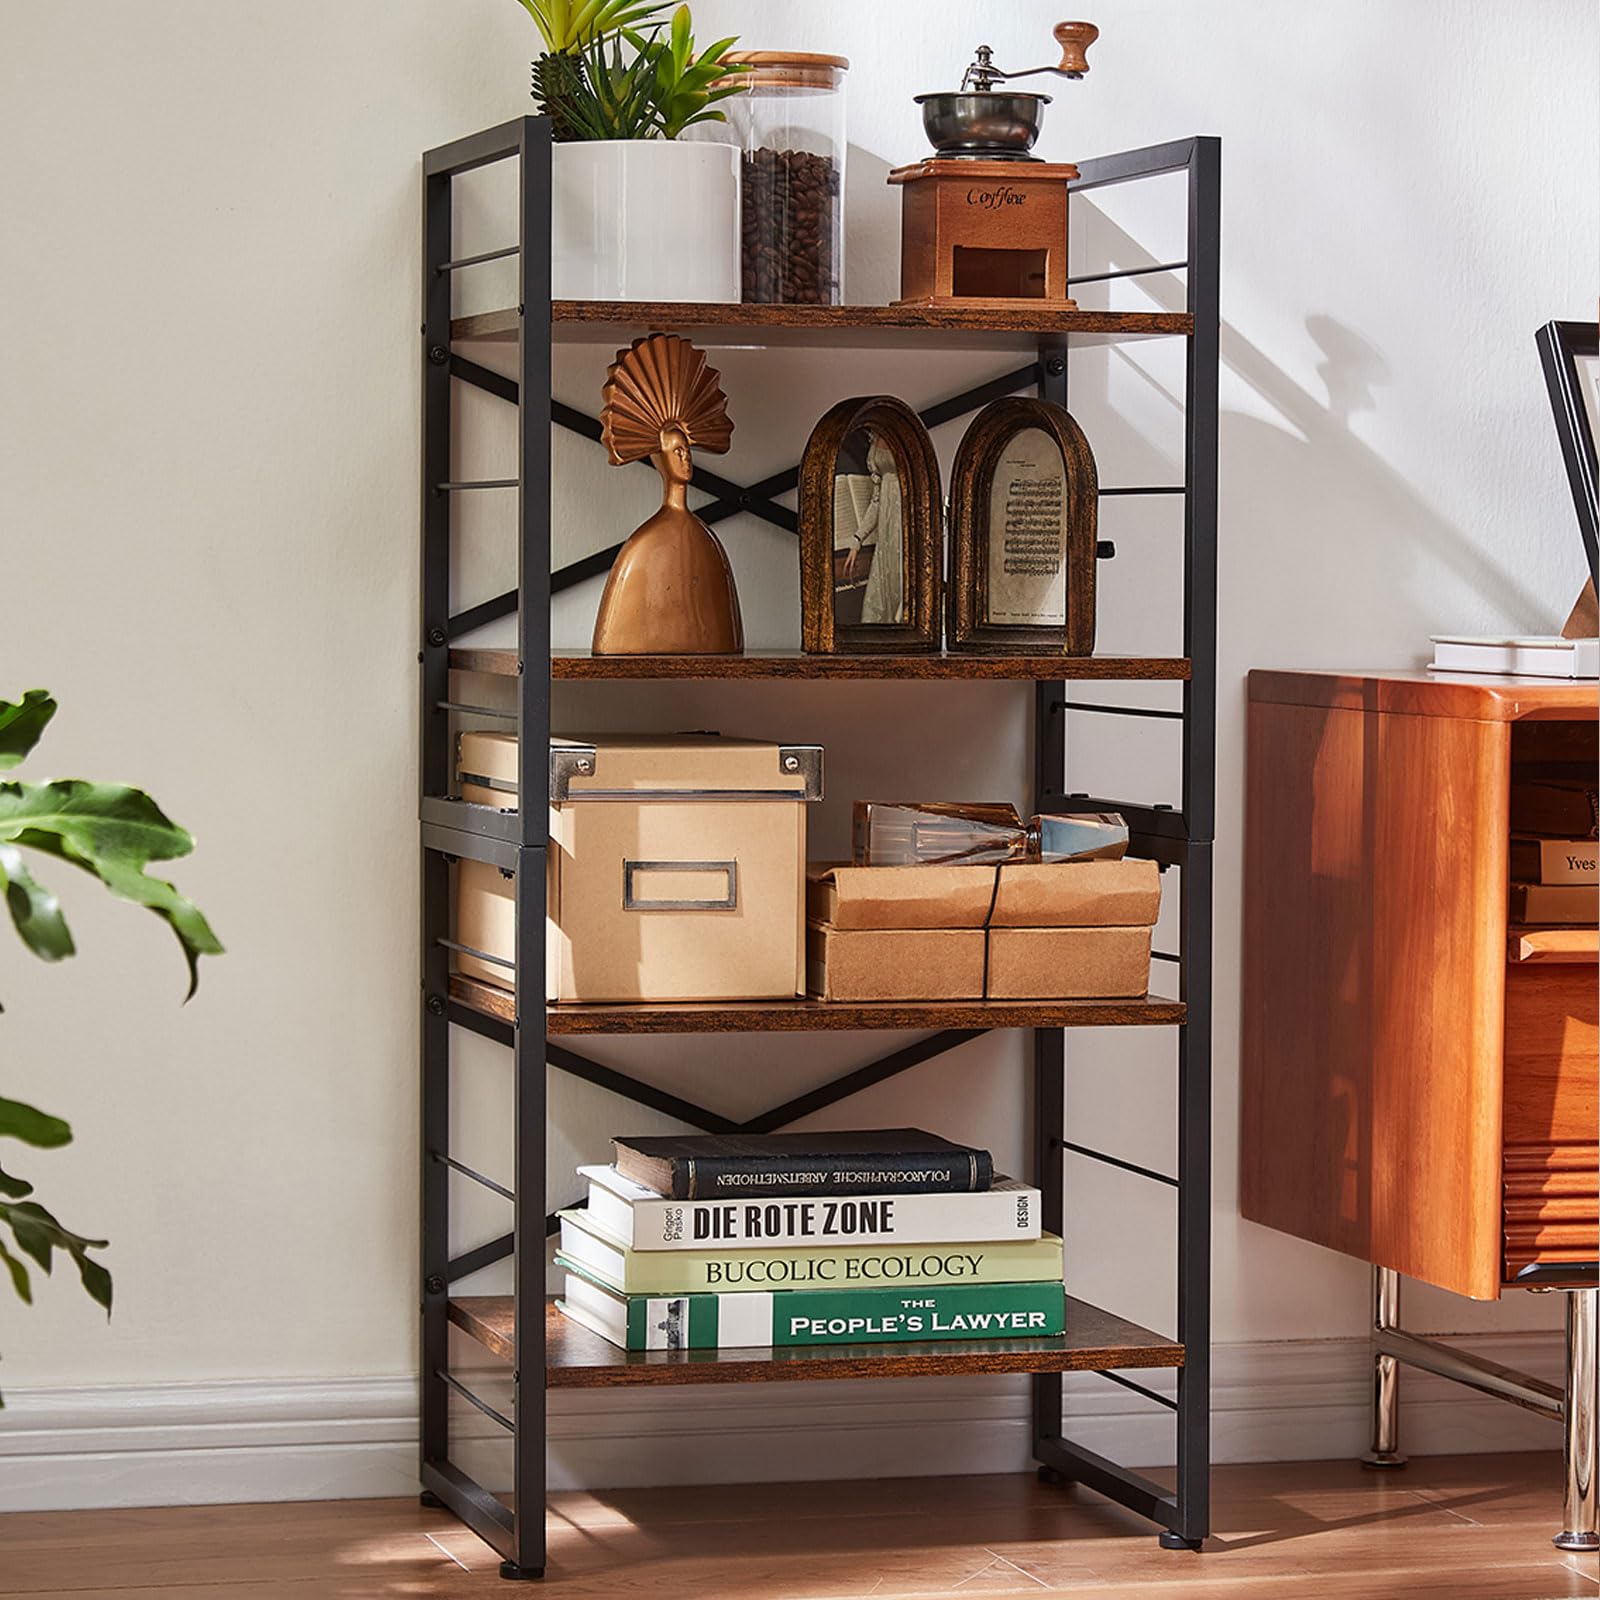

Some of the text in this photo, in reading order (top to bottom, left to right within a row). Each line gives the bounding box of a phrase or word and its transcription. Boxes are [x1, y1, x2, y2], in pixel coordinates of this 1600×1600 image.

[1566, 856, 1596, 871] Yves
[717, 1170, 950, 1186] POLAROGRAPHISCHE ARBEITSMETHODEN
[693, 1201, 894, 1240] DIE ROTE ZONE
[1017, 1195, 1028, 1228] DESIGN
[706, 1255, 984, 1283] BUCOLIC ECOLOGY
[901, 1299, 936, 1308] THE
[932, 1312, 1046, 1331] LAWYER
